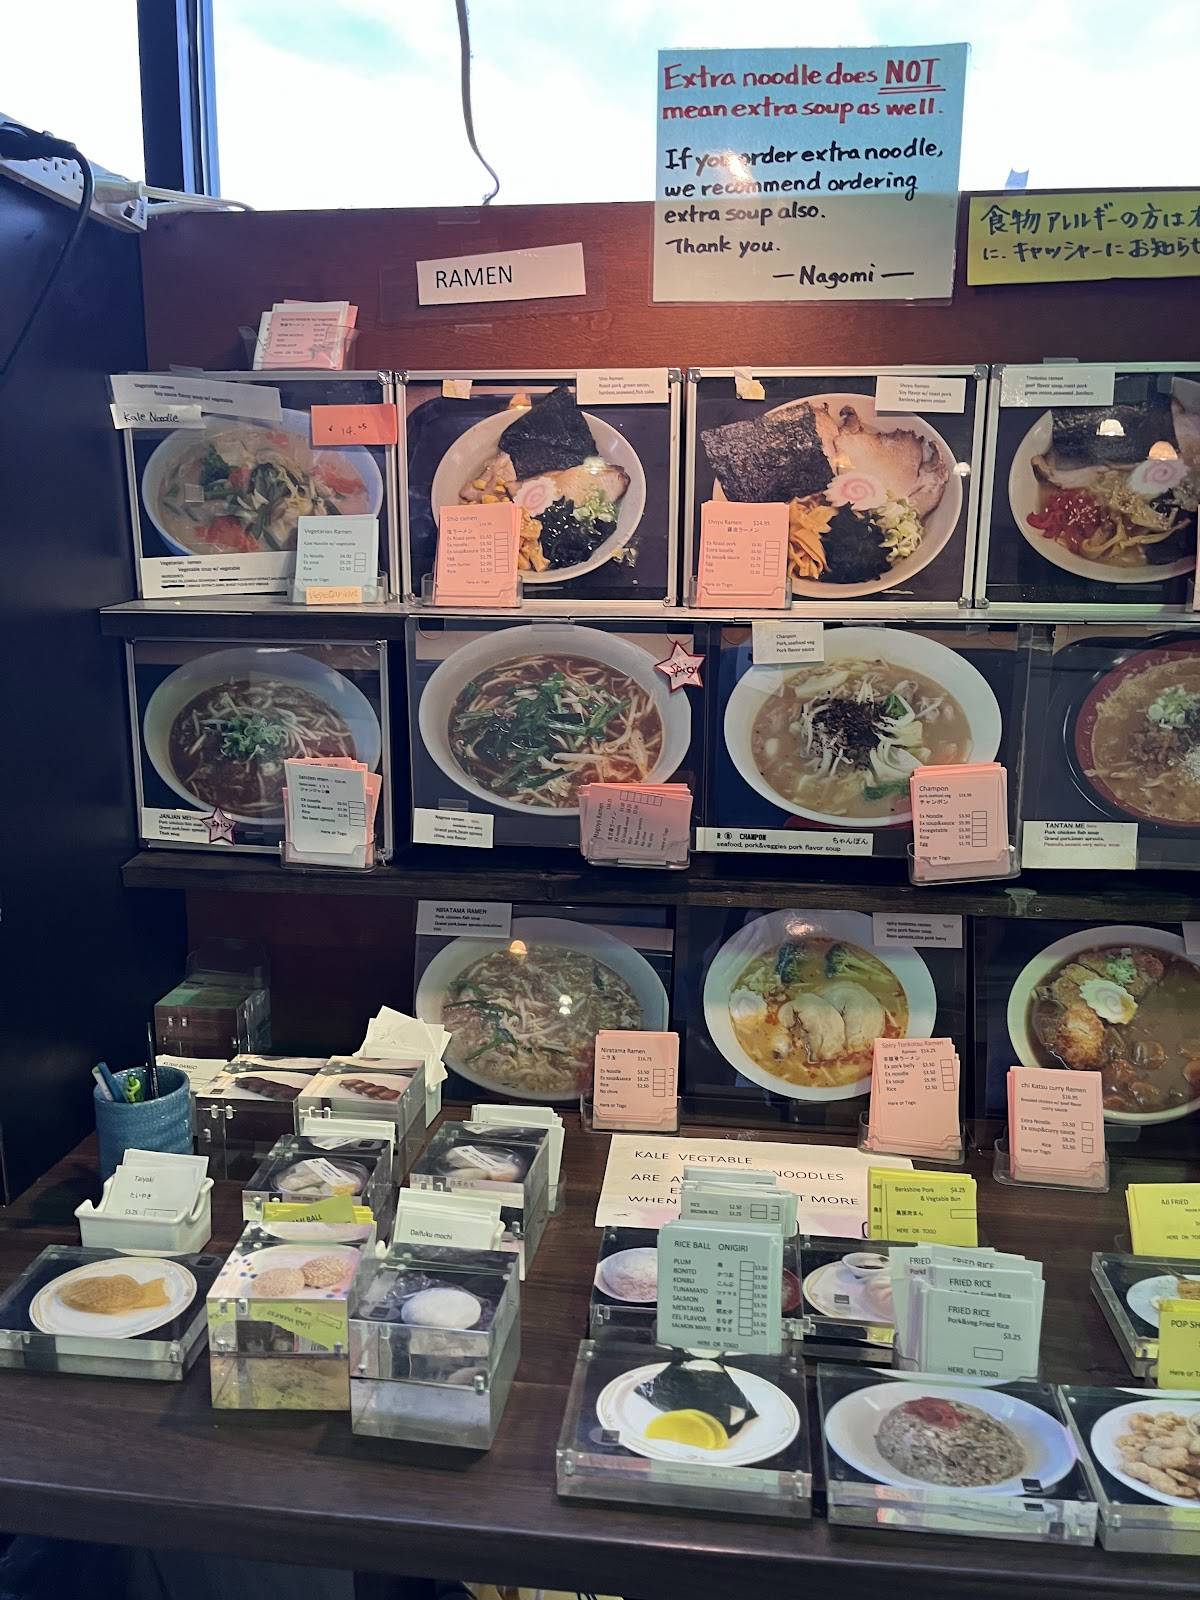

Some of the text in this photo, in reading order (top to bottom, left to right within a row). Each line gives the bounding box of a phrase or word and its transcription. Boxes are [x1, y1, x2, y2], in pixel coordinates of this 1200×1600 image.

[663, 59, 940, 91] Extra noodle does NOT
[662, 96, 943, 123] mean extra soup as well.
[665, 147, 692, 169] If
[801, 141, 859, 162] extra
[865, 137, 943, 159] noodle,
[664, 171, 918, 201] we recommend ordering
[664, 201, 825, 225] extra soup also.
[665, 235, 780, 258] Thank you.
[435, 265, 512, 289] RAMEN
[124, 413, 146, 422] Kale
[739, 833, 767, 841] CHAMPON
[1049, 1085, 1064, 1093] curry
[635, 1150, 753, 1165] KALE VEGTABLE
[631, 1173, 660, 1182] ARE
[772, 1170, 845, 1181] NOODLES
[628, 1195, 860, 1206] WHEN MORE
[305, 1214, 323, 1222] BALL
[411, 1229, 433, 1238] Daifuku
[693, 1242, 711, 1250] BALL
[718, 1243, 748, 1252] ONIGIRI
[910, 1257, 931, 1265] FRIED
[950, 1278, 992, 1288] FRIED RICE
[673, 1286, 708, 1294] TUNAMAYO
[672, 1304, 704, 1312] MENTAIKO
[948, 1305, 991, 1317] FRIED RICE
[980, 1369, 998, 1377] TOGO
